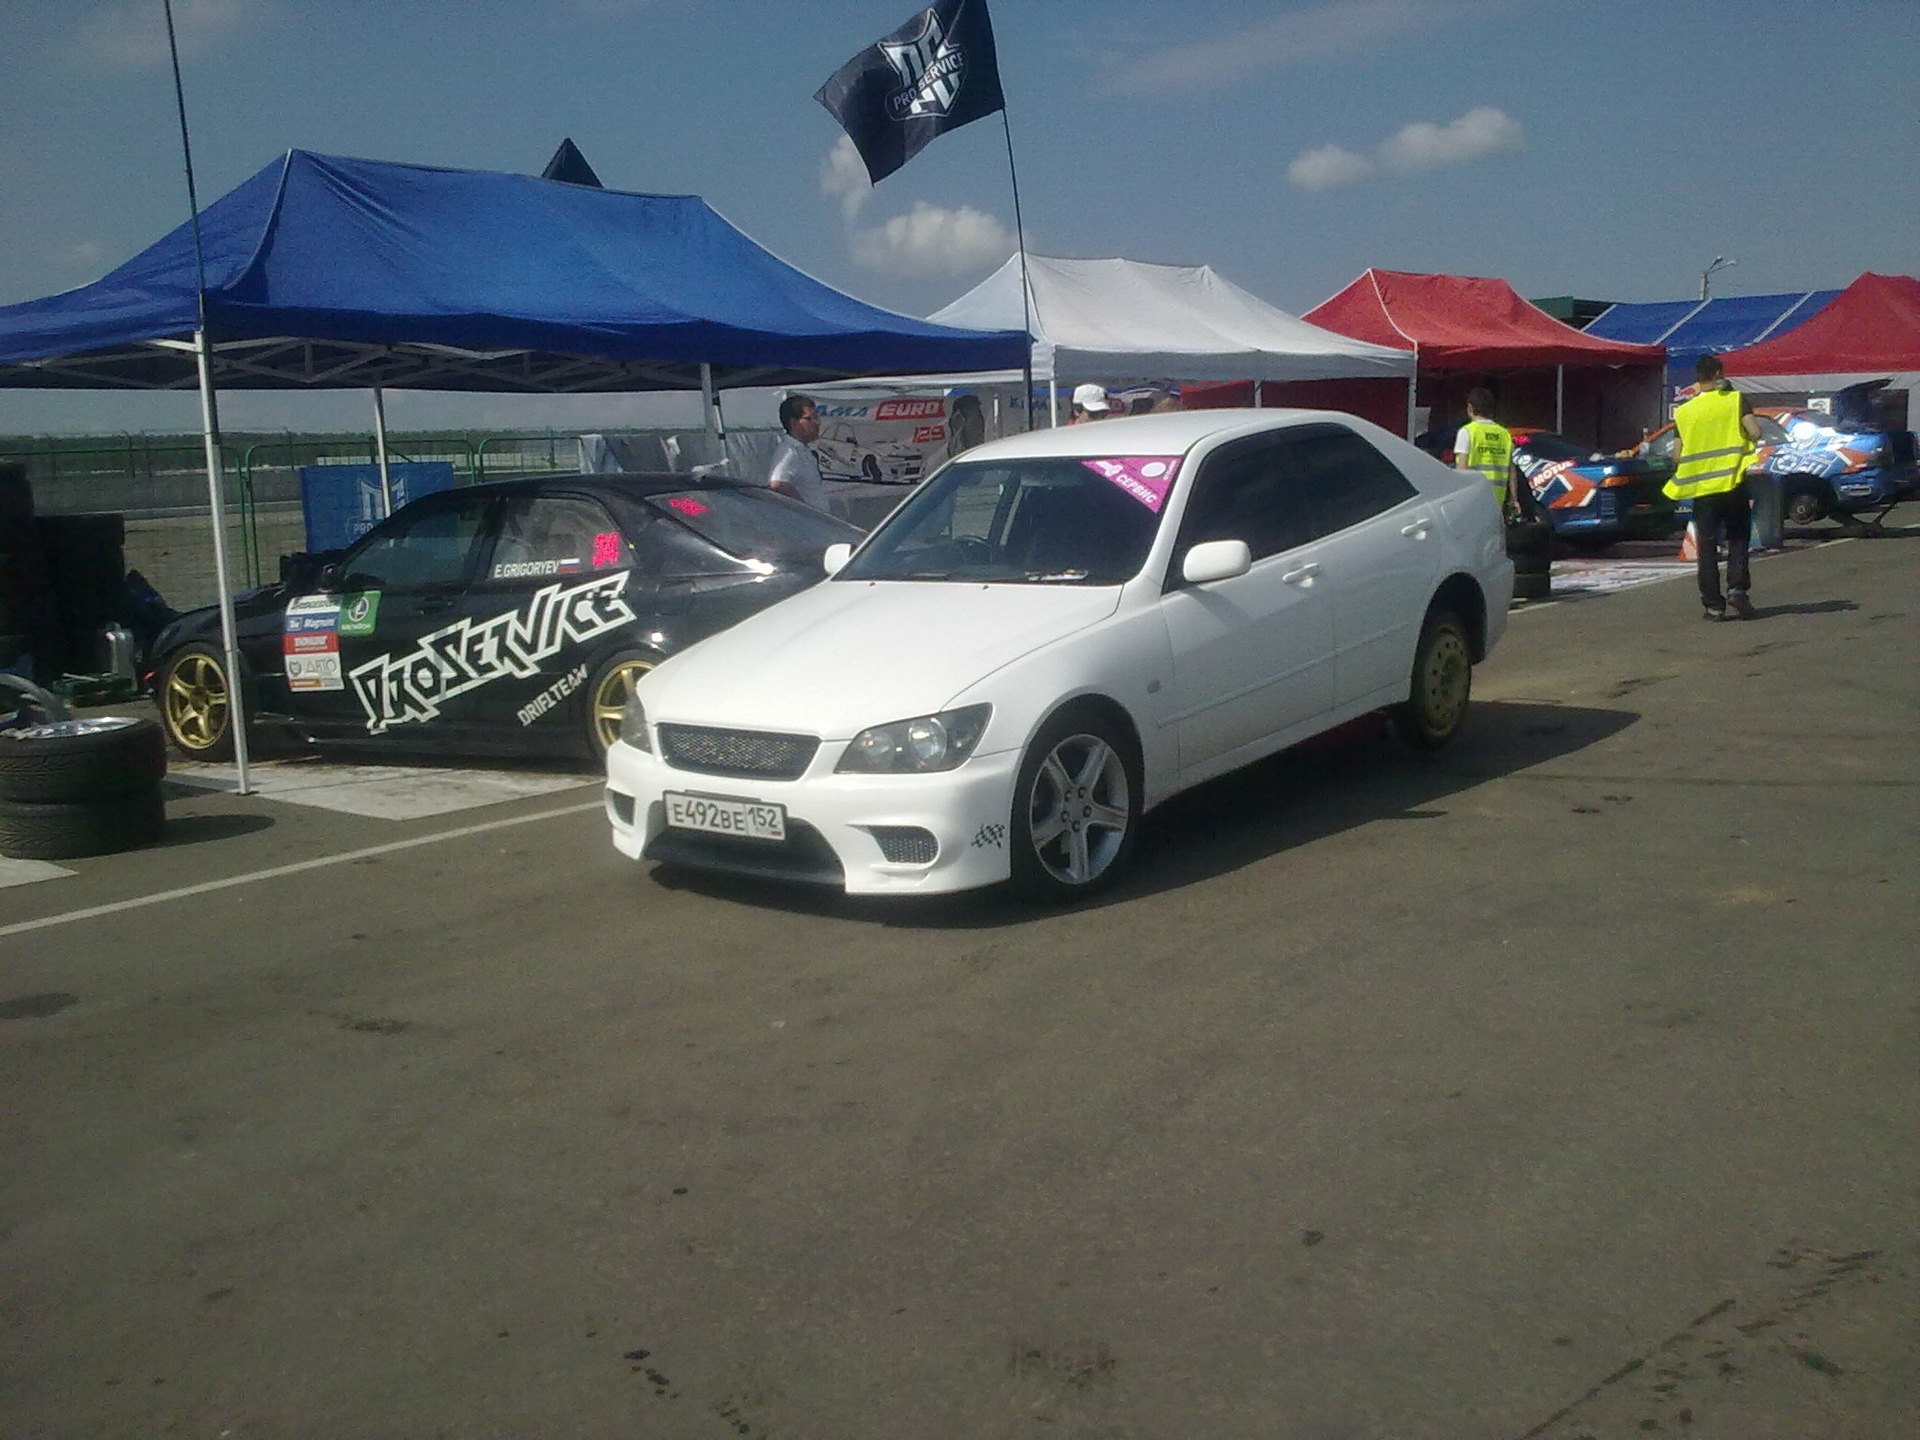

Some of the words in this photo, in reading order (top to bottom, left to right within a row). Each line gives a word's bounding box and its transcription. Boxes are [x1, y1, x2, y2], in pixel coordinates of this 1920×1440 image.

[894, 88, 917, 110] PRO
[918, 52, 964, 89] SERVICE
[878, 401, 940, 417] EURO
[1532, 460, 1575, 487] MOTUL
[1116, 474, 1157, 503] СЕРВИС
[494, 560, 561, 579] E.GRIGORYEV
